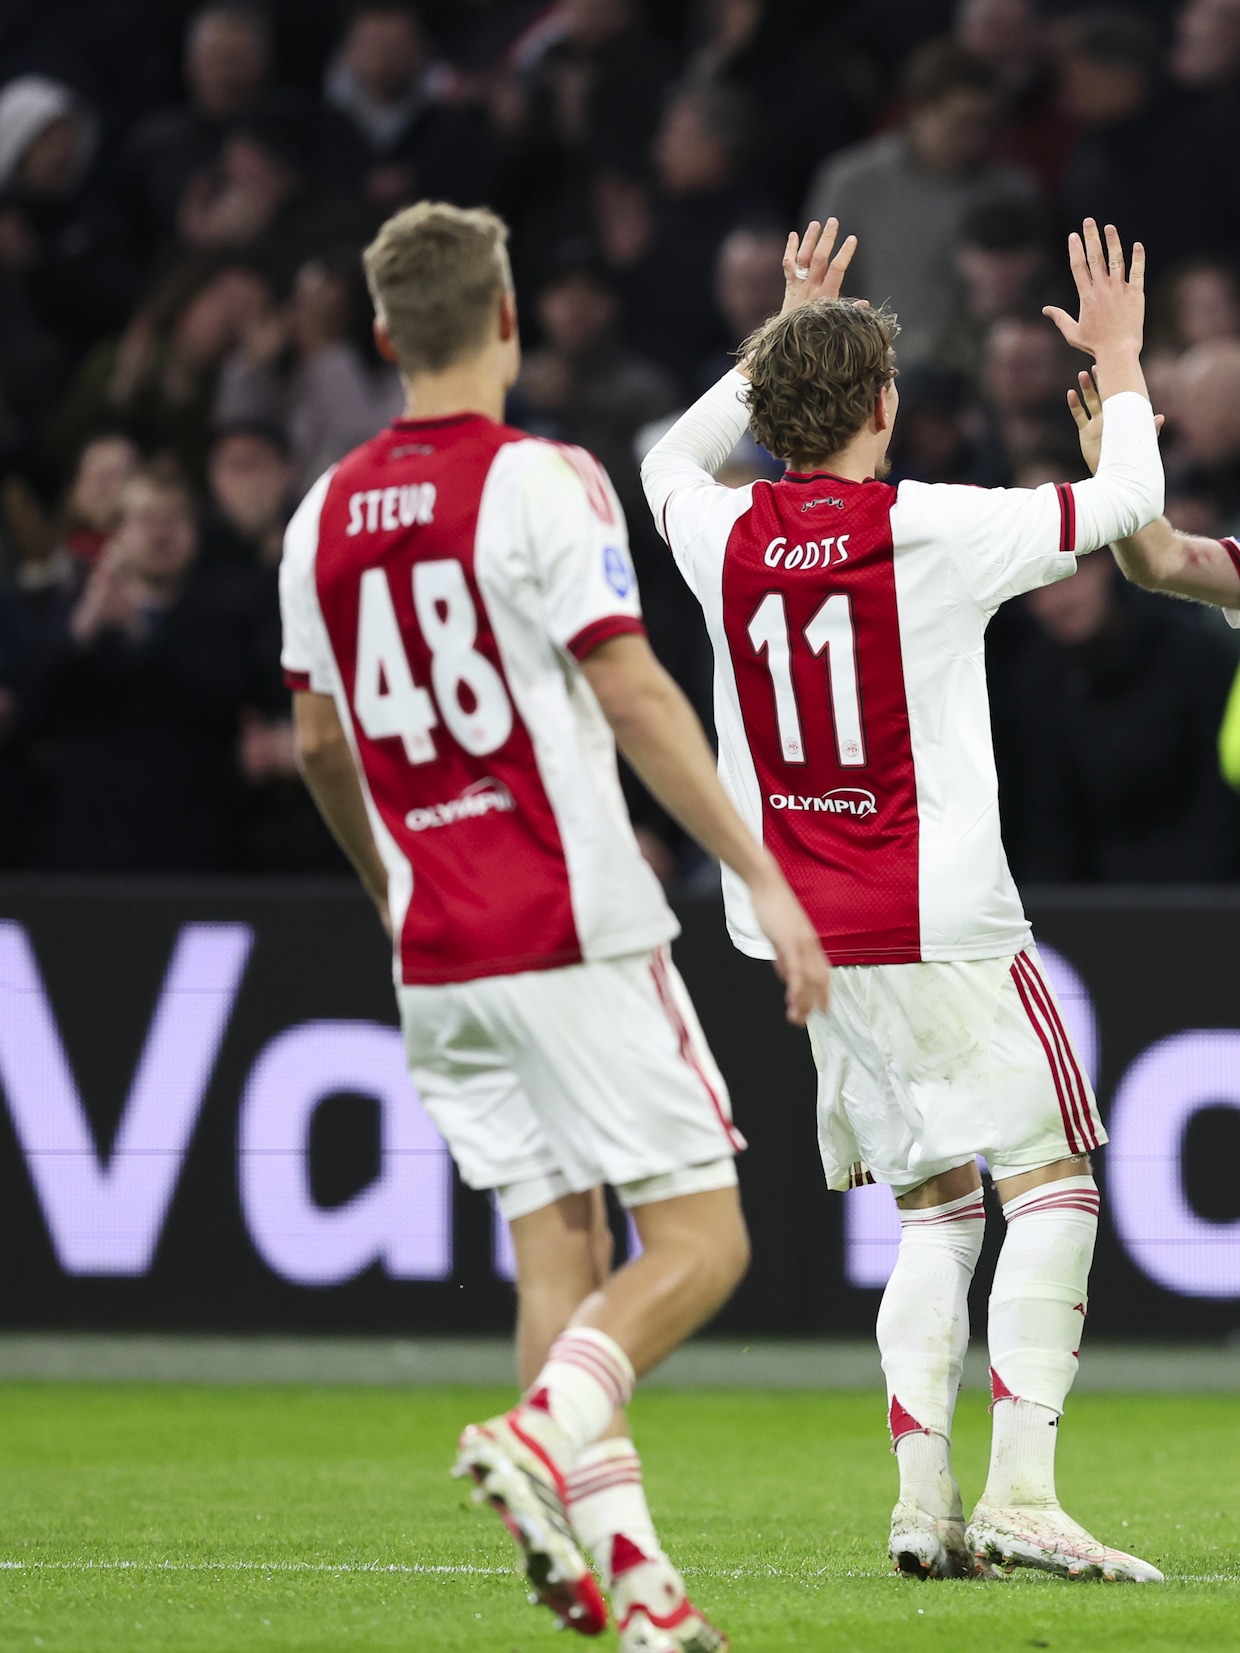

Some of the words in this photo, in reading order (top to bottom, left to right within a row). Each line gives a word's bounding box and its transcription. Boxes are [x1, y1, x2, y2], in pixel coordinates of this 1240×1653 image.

[345, 482, 437, 537] STEUR
[763, 534, 850, 571] GODTS
[354, 558, 512, 765] 48
[745, 591, 867, 769] 11
[768, 791, 878, 816] OLYMPIA
[0, 919, 642, 1285] Va
